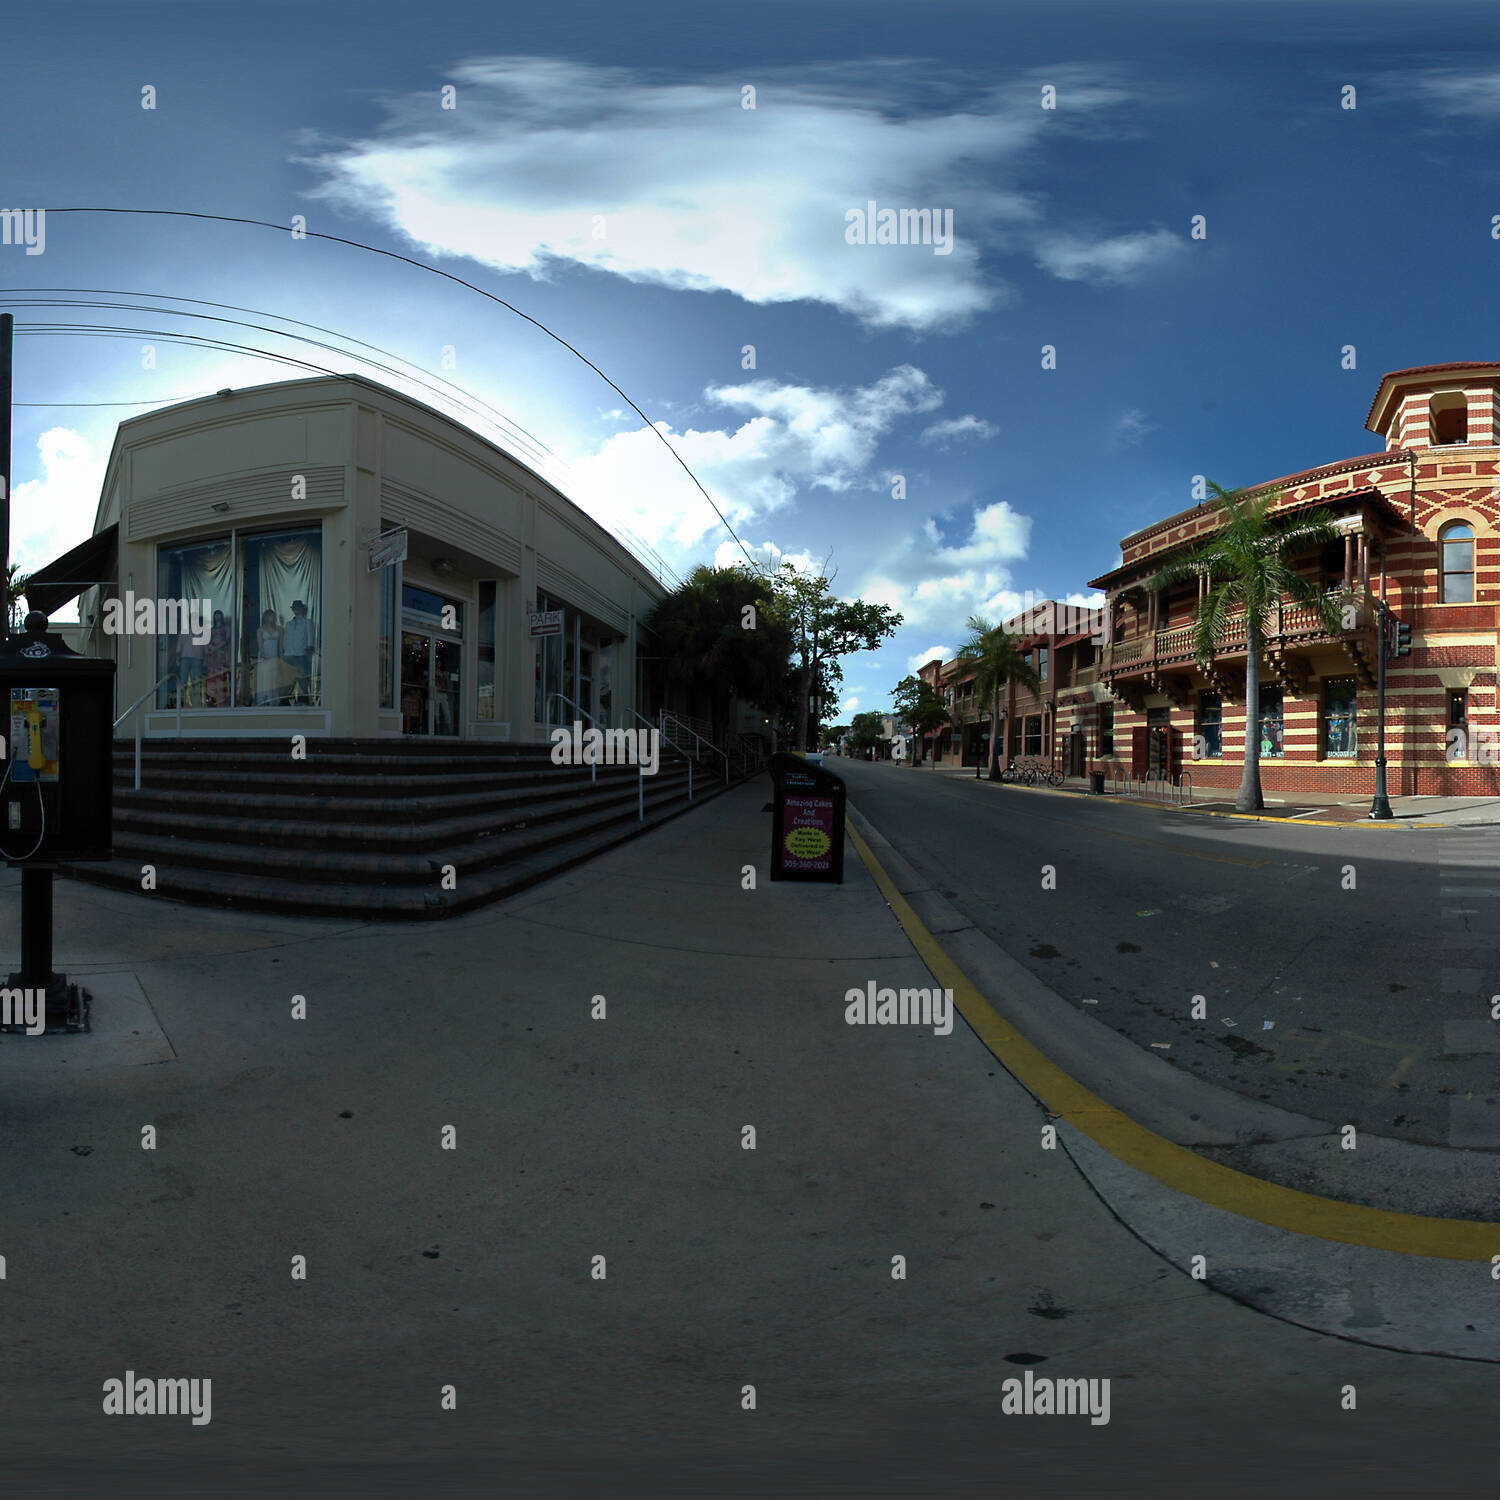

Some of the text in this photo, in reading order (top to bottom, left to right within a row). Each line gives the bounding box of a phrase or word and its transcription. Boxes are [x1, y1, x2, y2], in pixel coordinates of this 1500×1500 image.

[530, 610, 561, 626] PARK
[786, 799, 832, 808] Amazing Cakes
